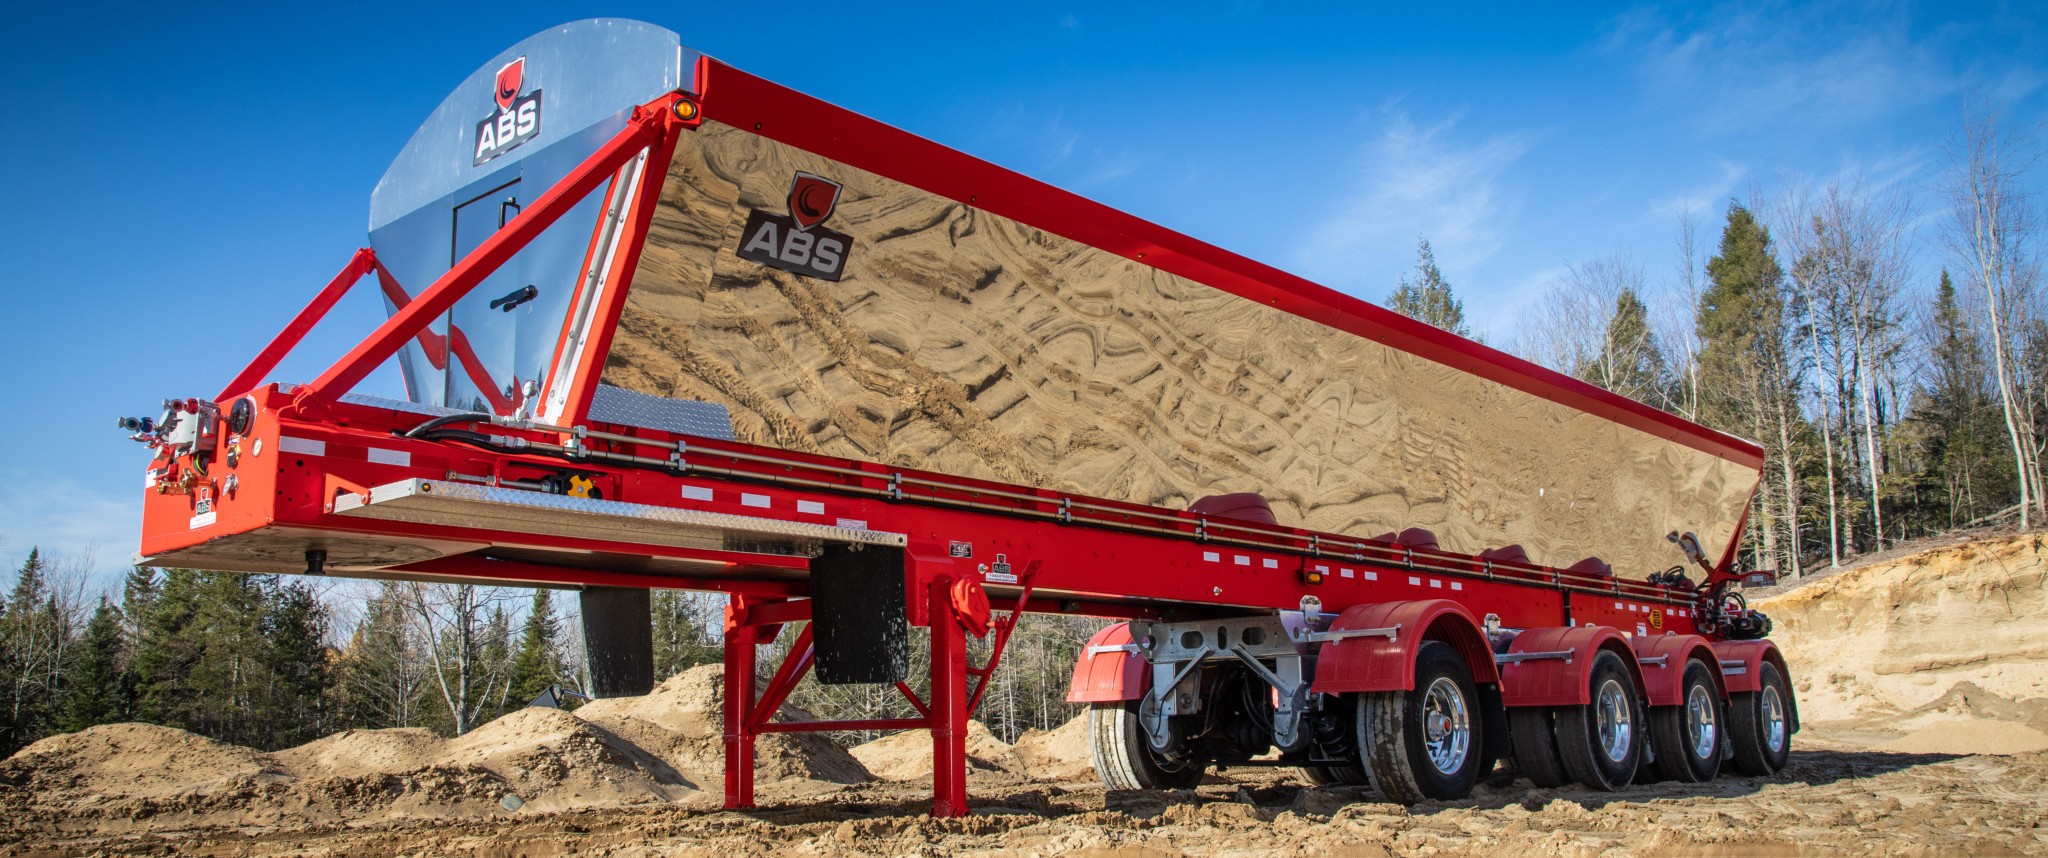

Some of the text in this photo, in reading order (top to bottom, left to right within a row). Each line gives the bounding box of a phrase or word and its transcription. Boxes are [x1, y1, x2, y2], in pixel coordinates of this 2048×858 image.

[476, 99, 537, 159] ABS
[743, 220, 844, 274] ABS
[196, 500, 211, 514] ABS
[994, 564, 1010, 573] ABS
